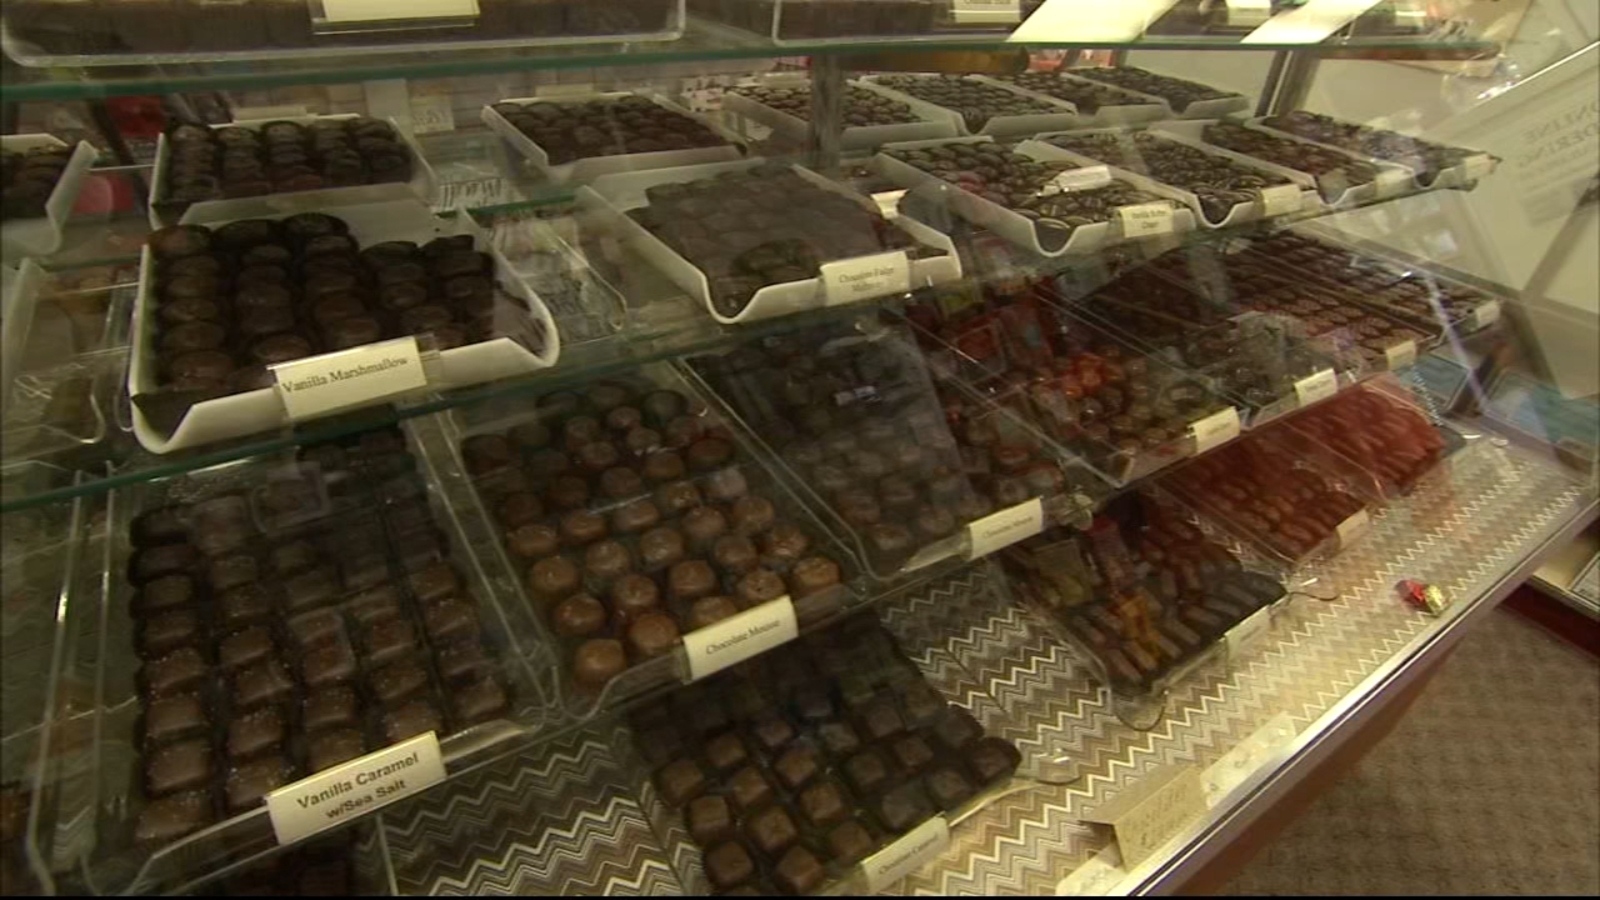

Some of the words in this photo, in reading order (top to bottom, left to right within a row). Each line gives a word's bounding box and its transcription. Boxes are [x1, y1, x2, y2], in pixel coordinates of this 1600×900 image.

[282, 374, 328, 393] Vanilla
[329, 356, 408, 383] Marshmallow
[706, 631, 748, 655] Chocolate
[748, 619, 781, 637] Mousse
[296, 776, 353, 809] Vanilla
[355, 751, 420, 787] Caramel
[325, 795, 374, 819] w/Sea
[376, 778, 407, 797] Salt
